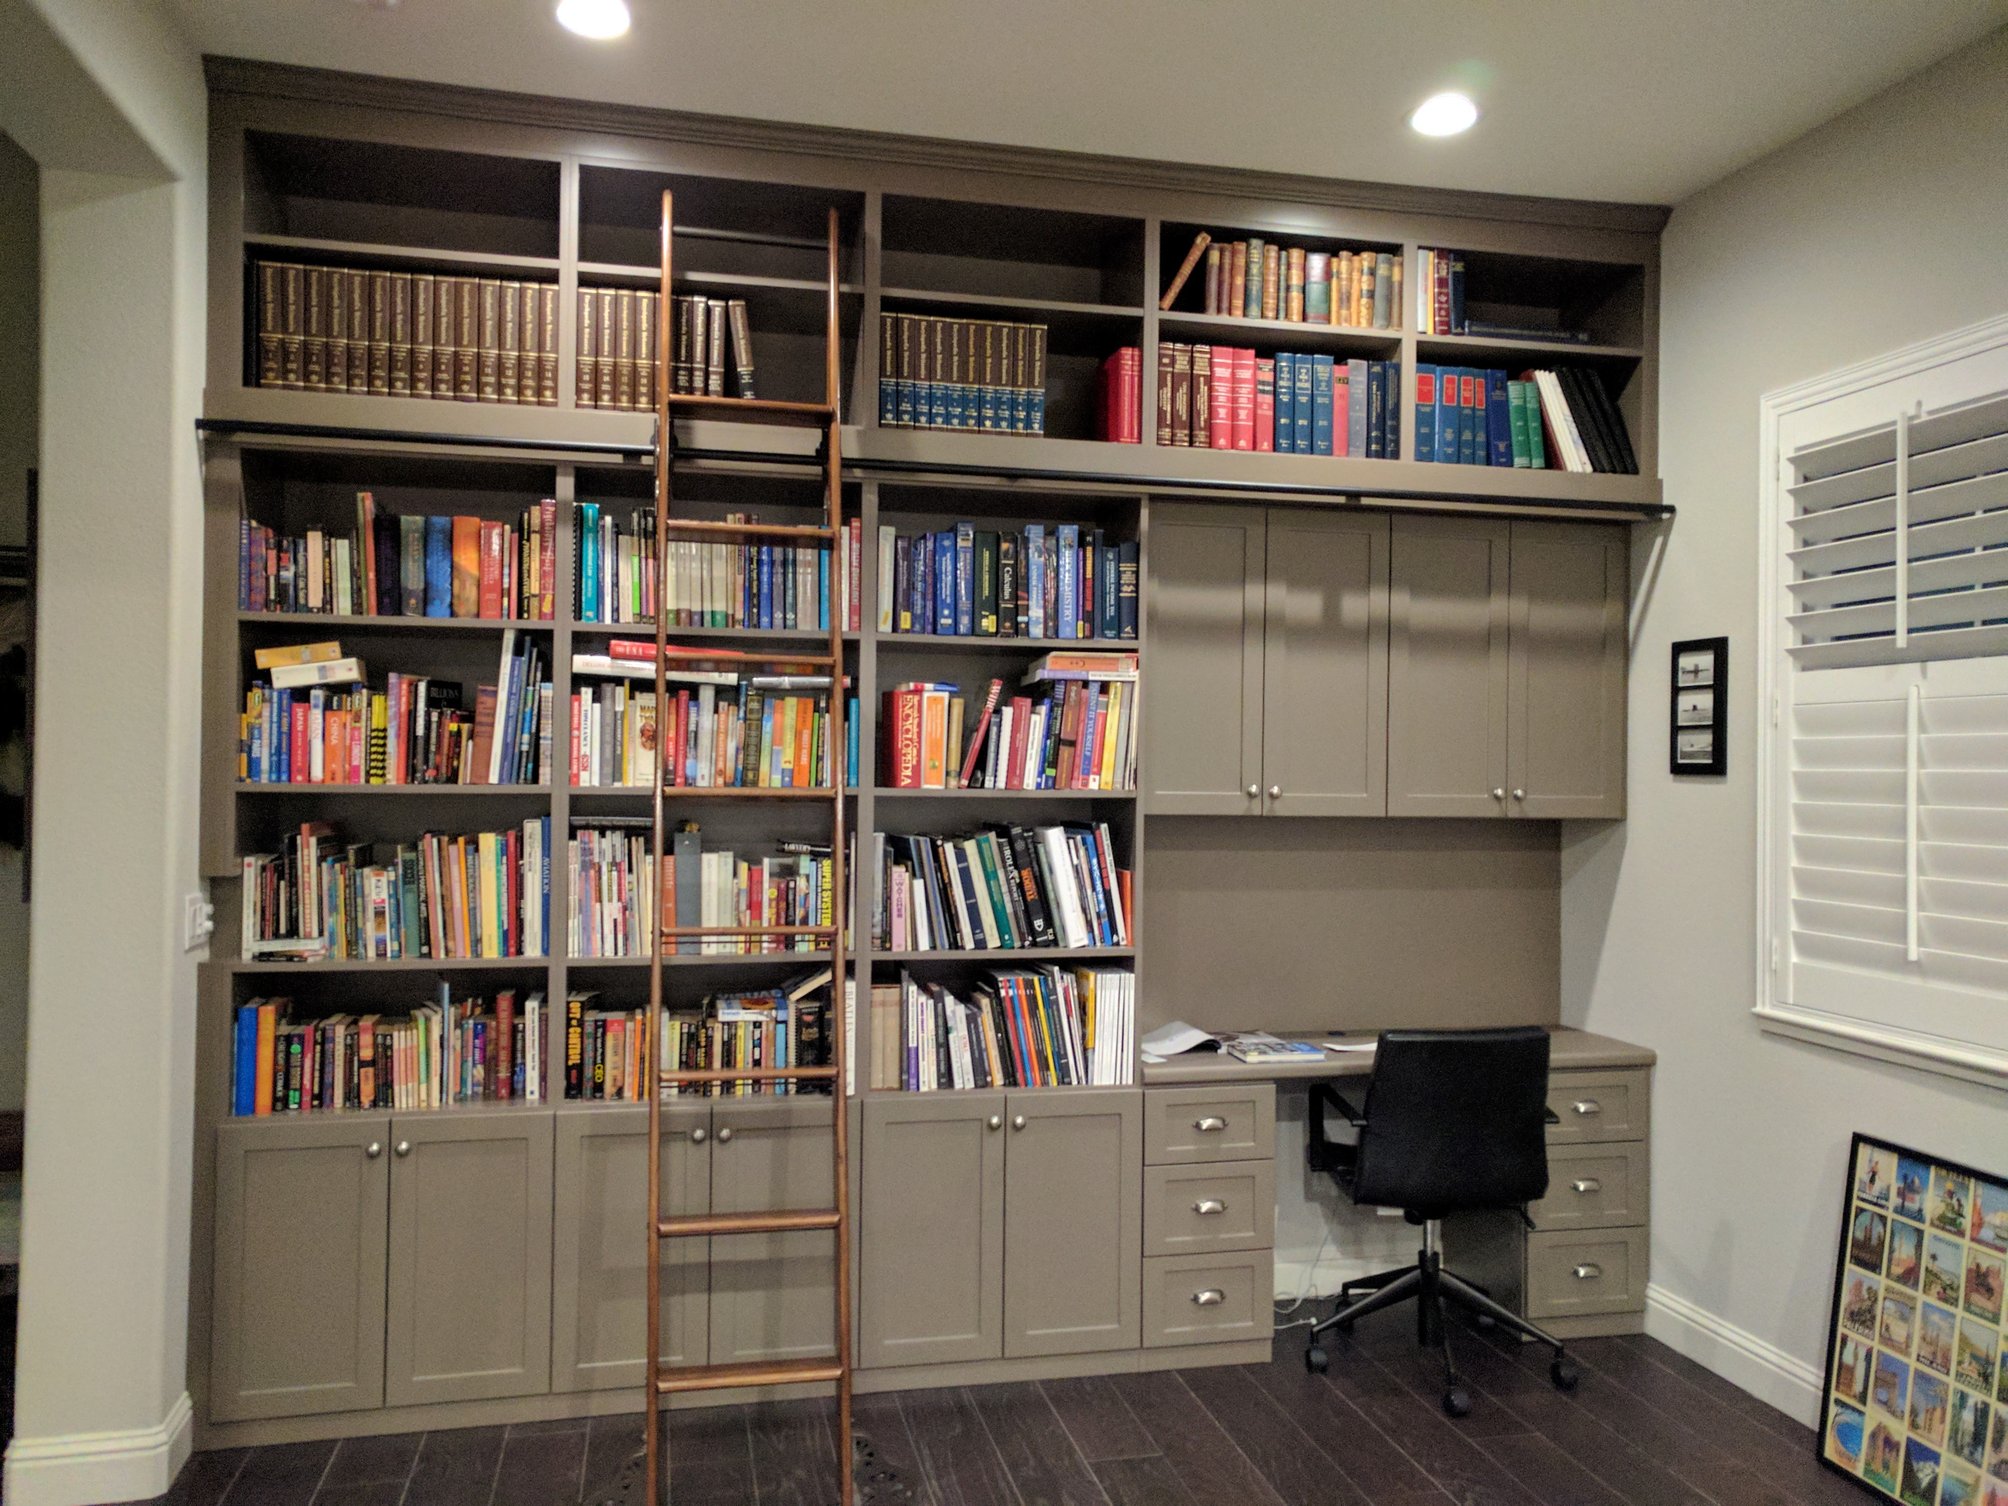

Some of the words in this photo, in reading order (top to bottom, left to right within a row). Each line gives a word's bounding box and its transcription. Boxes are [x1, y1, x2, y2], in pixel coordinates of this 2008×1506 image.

[1004, 567, 1012, 599] Calculus
[1064, 550, 1072, 622] BIOCHEMISTRY
[985, 685, 1001, 712] wine
[1088, 682, 1098, 710] PATENT
[331, 717, 340, 744] CHINA
[900, 695, 913, 786] ENCYCLOPEDIA
[1085, 720, 1094, 757] YOURSELF
[822, 860, 832, 890] SUPER
[1003, 850, 1017, 879] ROLEX
[569, 1002, 581, 1018] OUT
[568, 1027, 582, 1066] CONTROL
[595, 1064, 603, 1082] CEO
